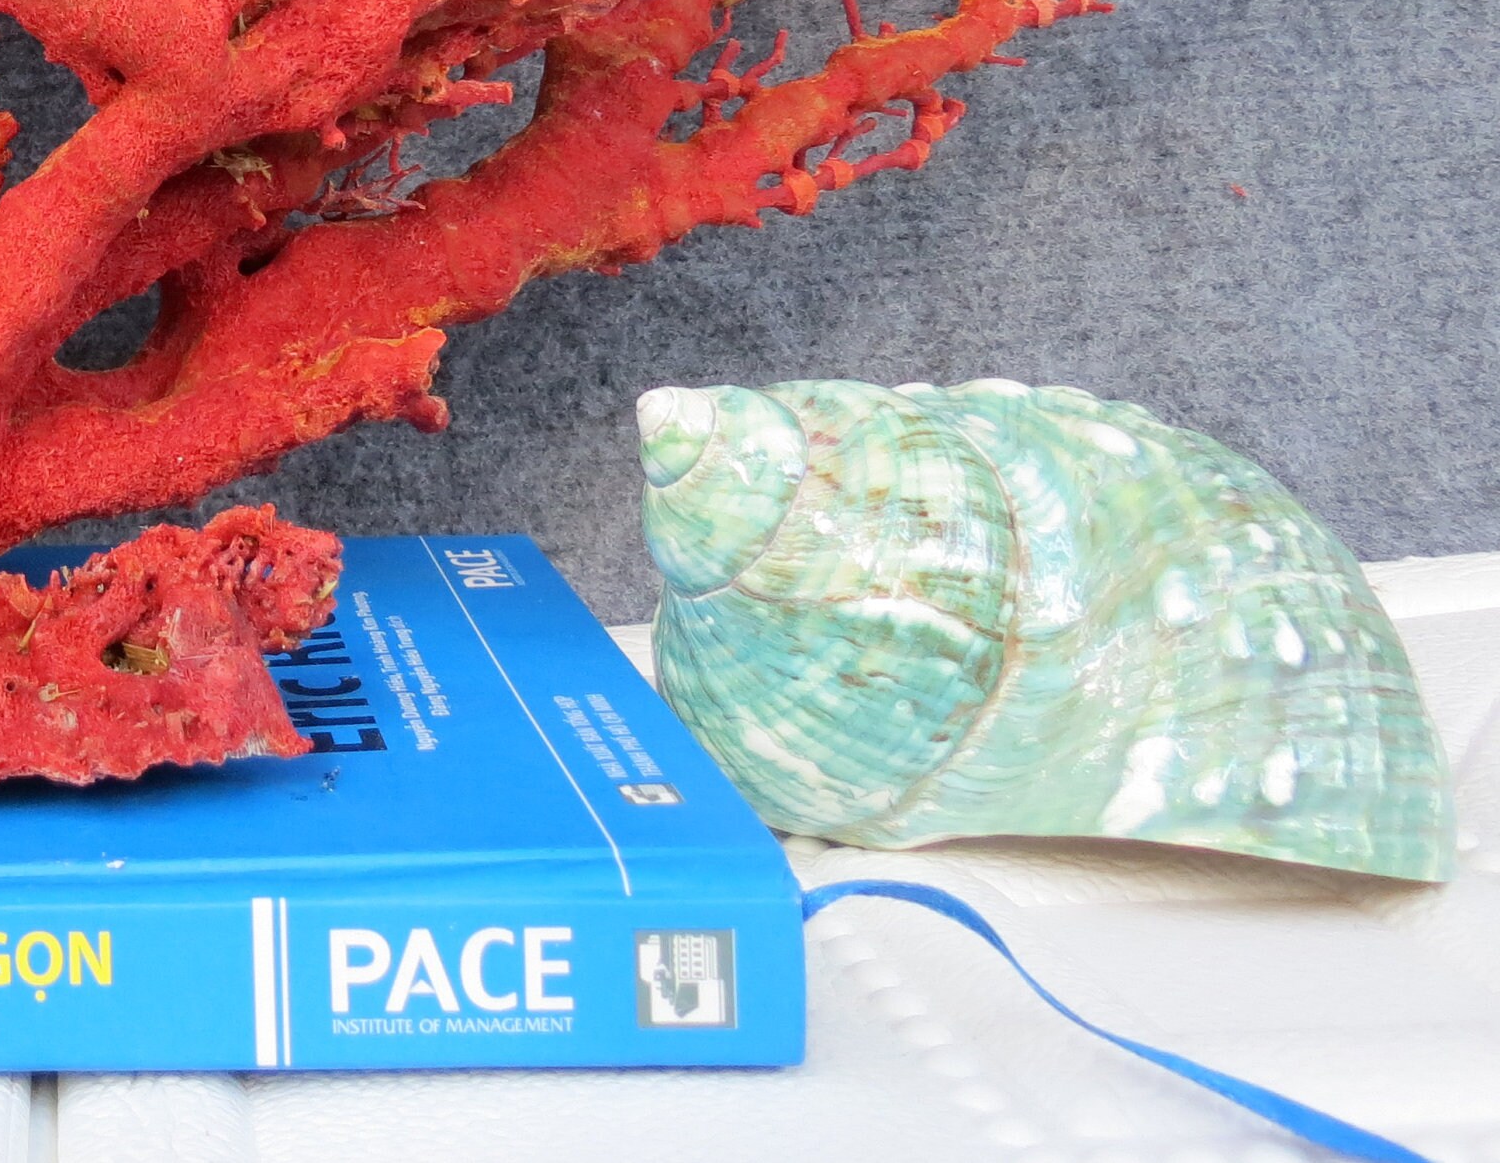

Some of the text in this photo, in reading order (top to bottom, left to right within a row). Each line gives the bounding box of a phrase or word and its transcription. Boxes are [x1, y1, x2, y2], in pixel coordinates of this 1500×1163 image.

[444, 549, 514, 588] PACE
[361, 616, 379, 631] Kim
[397, 628, 415, 649] Trung
[409, 667, 441, 695] Nguyễn
[404, 719, 439, 751] Nguyễn
[329, 926, 575, 1012] PACE
[332, 1016, 574, 1035] INSTITUTE OF MANAGEMENT
